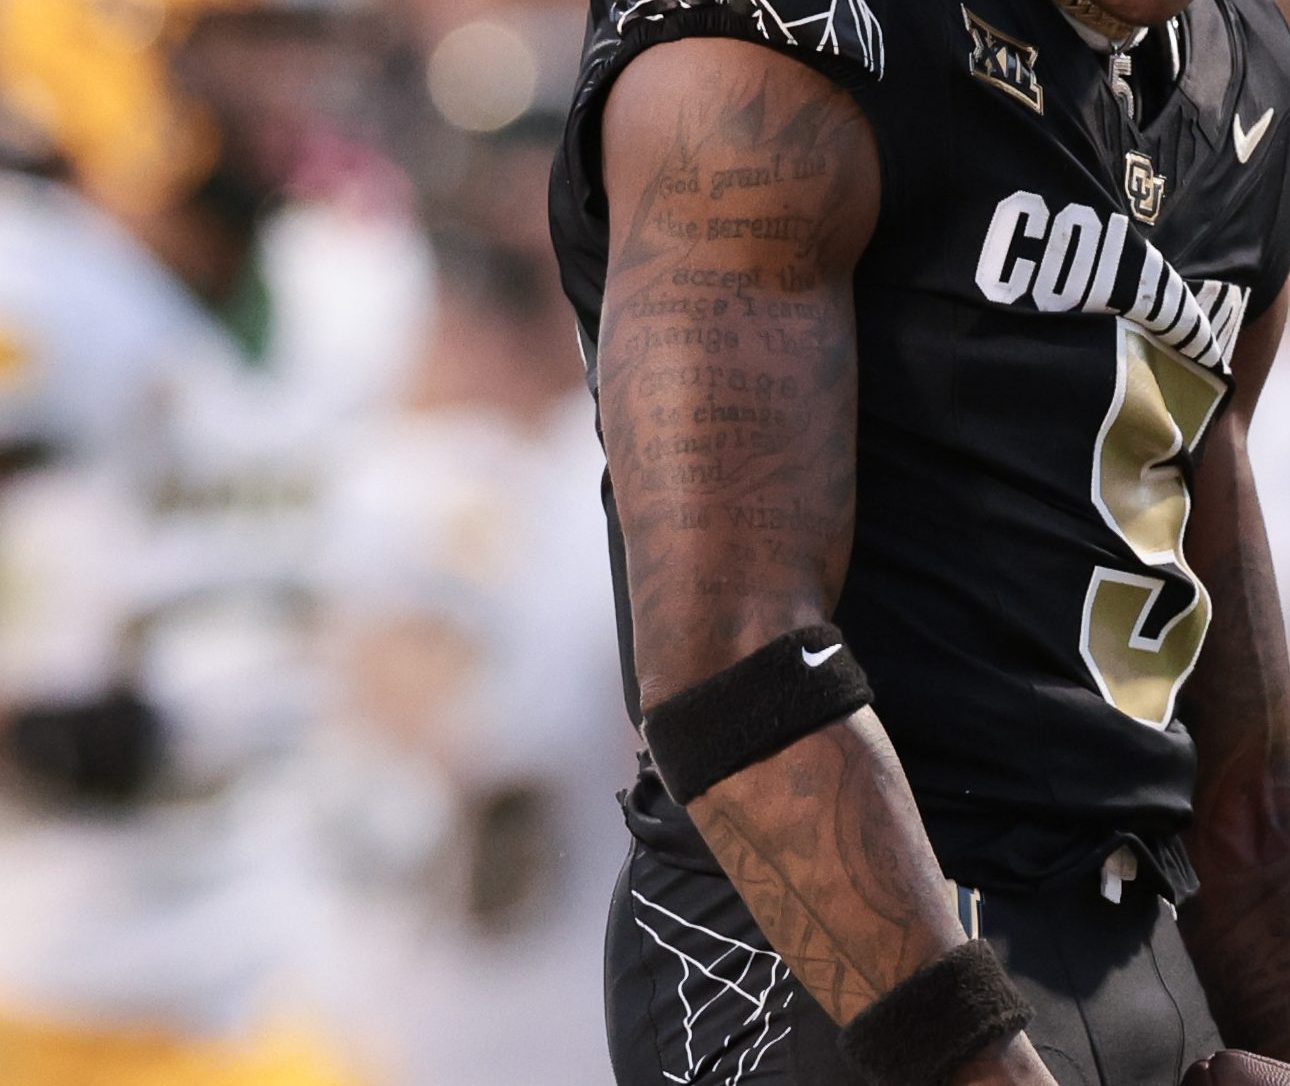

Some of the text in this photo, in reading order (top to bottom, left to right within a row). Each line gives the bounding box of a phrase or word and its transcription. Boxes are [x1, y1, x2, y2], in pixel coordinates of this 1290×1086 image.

[710, 154, 784, 200] grant
[673, 265, 763, 298] accept
[975, 190, 1251, 375] COLO
[1079, 316, 1228, 733] 5
